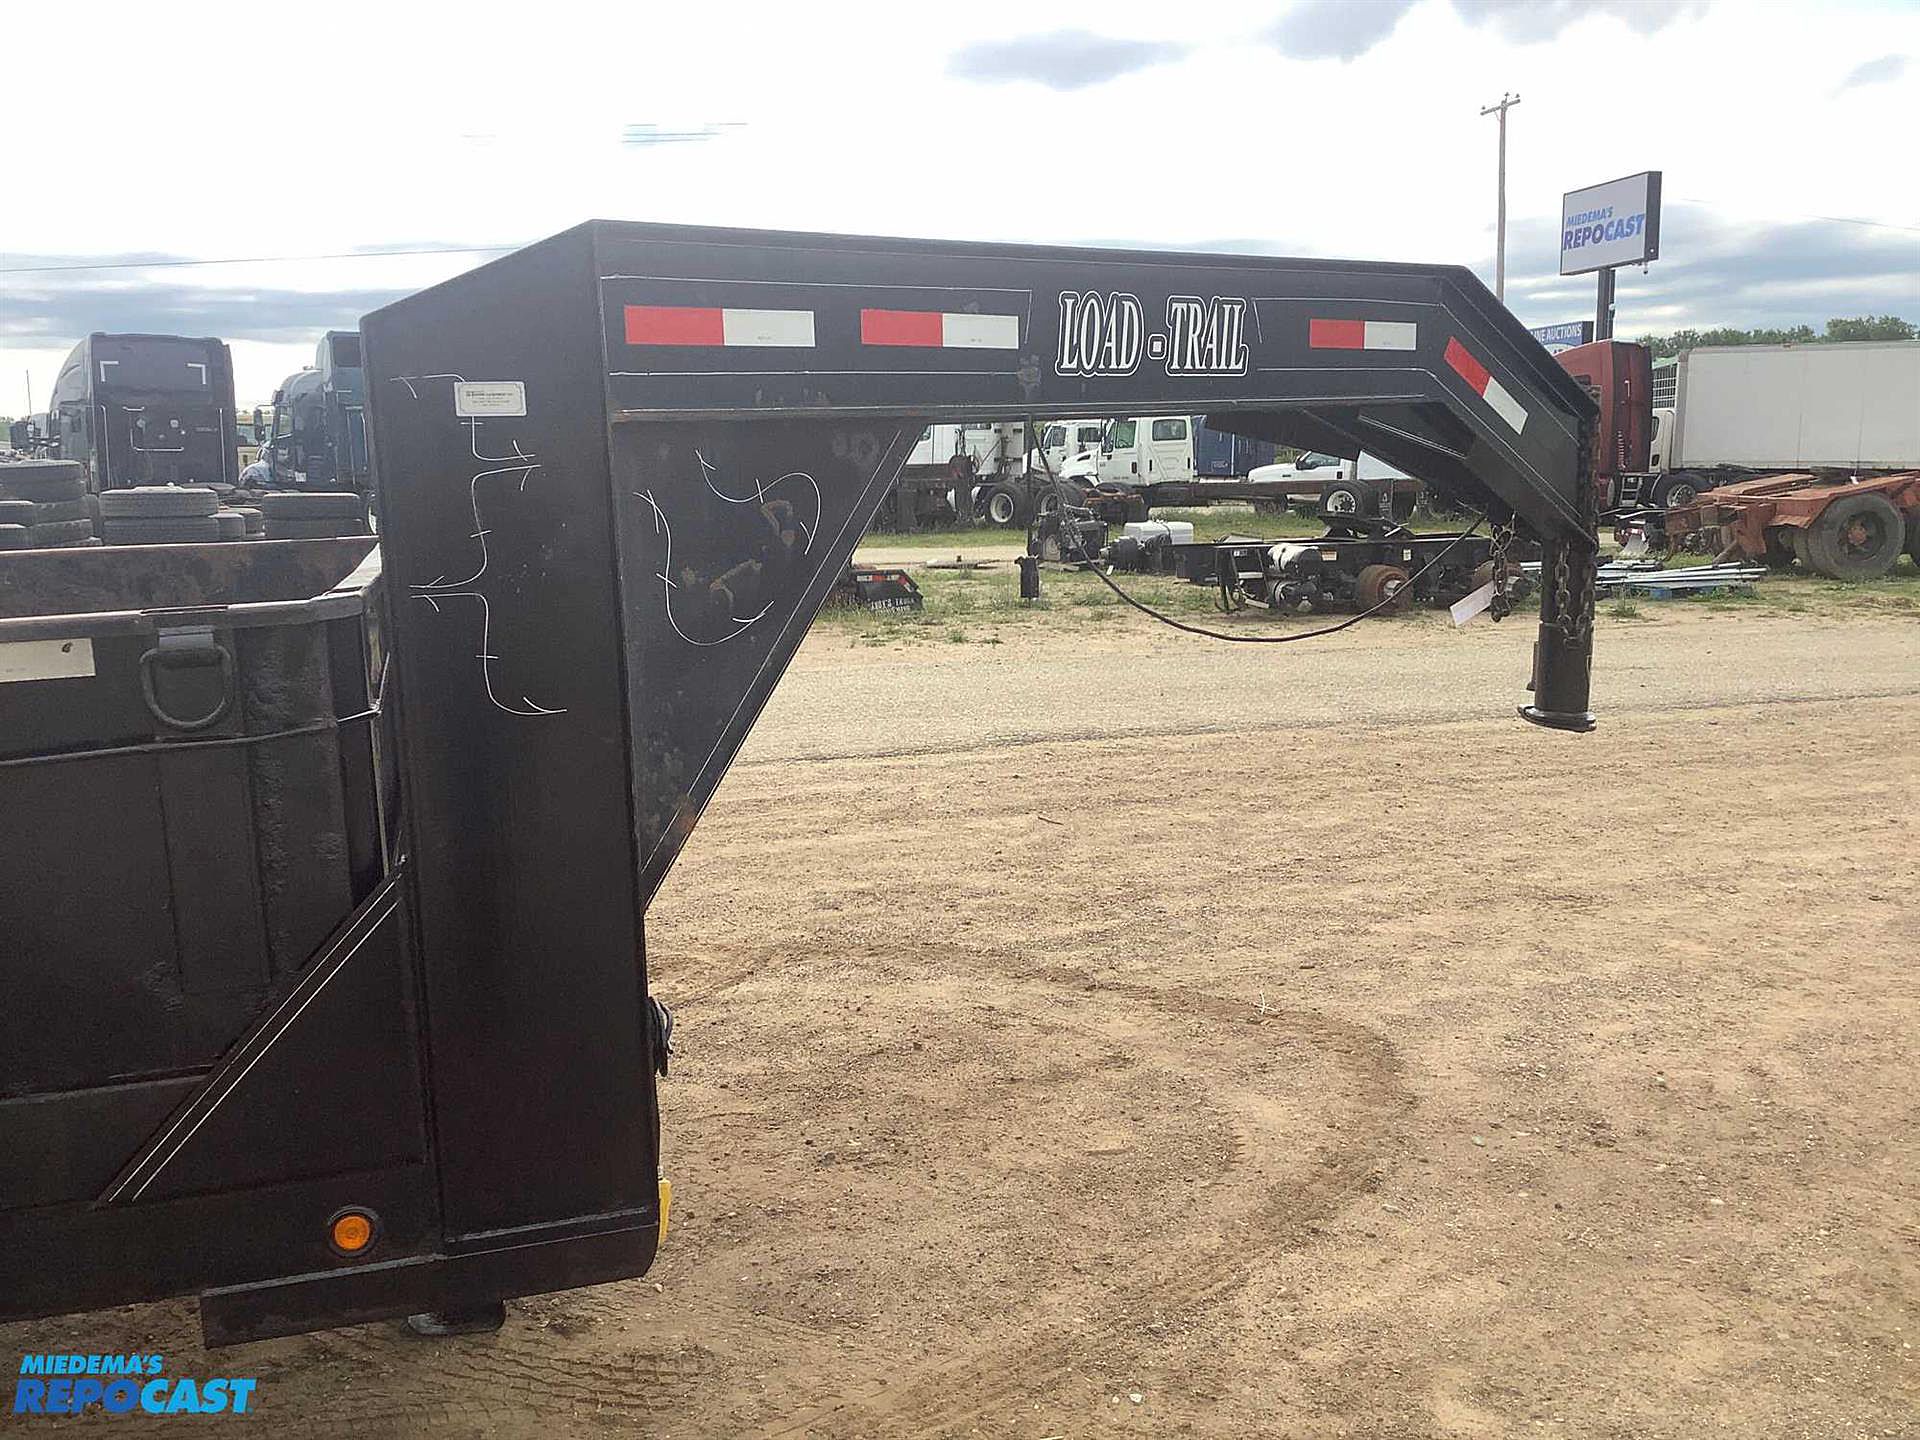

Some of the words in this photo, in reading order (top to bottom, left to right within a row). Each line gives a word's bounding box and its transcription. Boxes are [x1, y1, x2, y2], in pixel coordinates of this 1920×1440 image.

[1566, 206, 1613, 225] MIEDEMA'S
[1563, 213, 1645, 250] REPOCAST
[1057, 294, 1142, 374] LOAD
[1167, 299, 1247, 374] TRAIL
[1546, 322, 1582, 341] AUCTIONS
